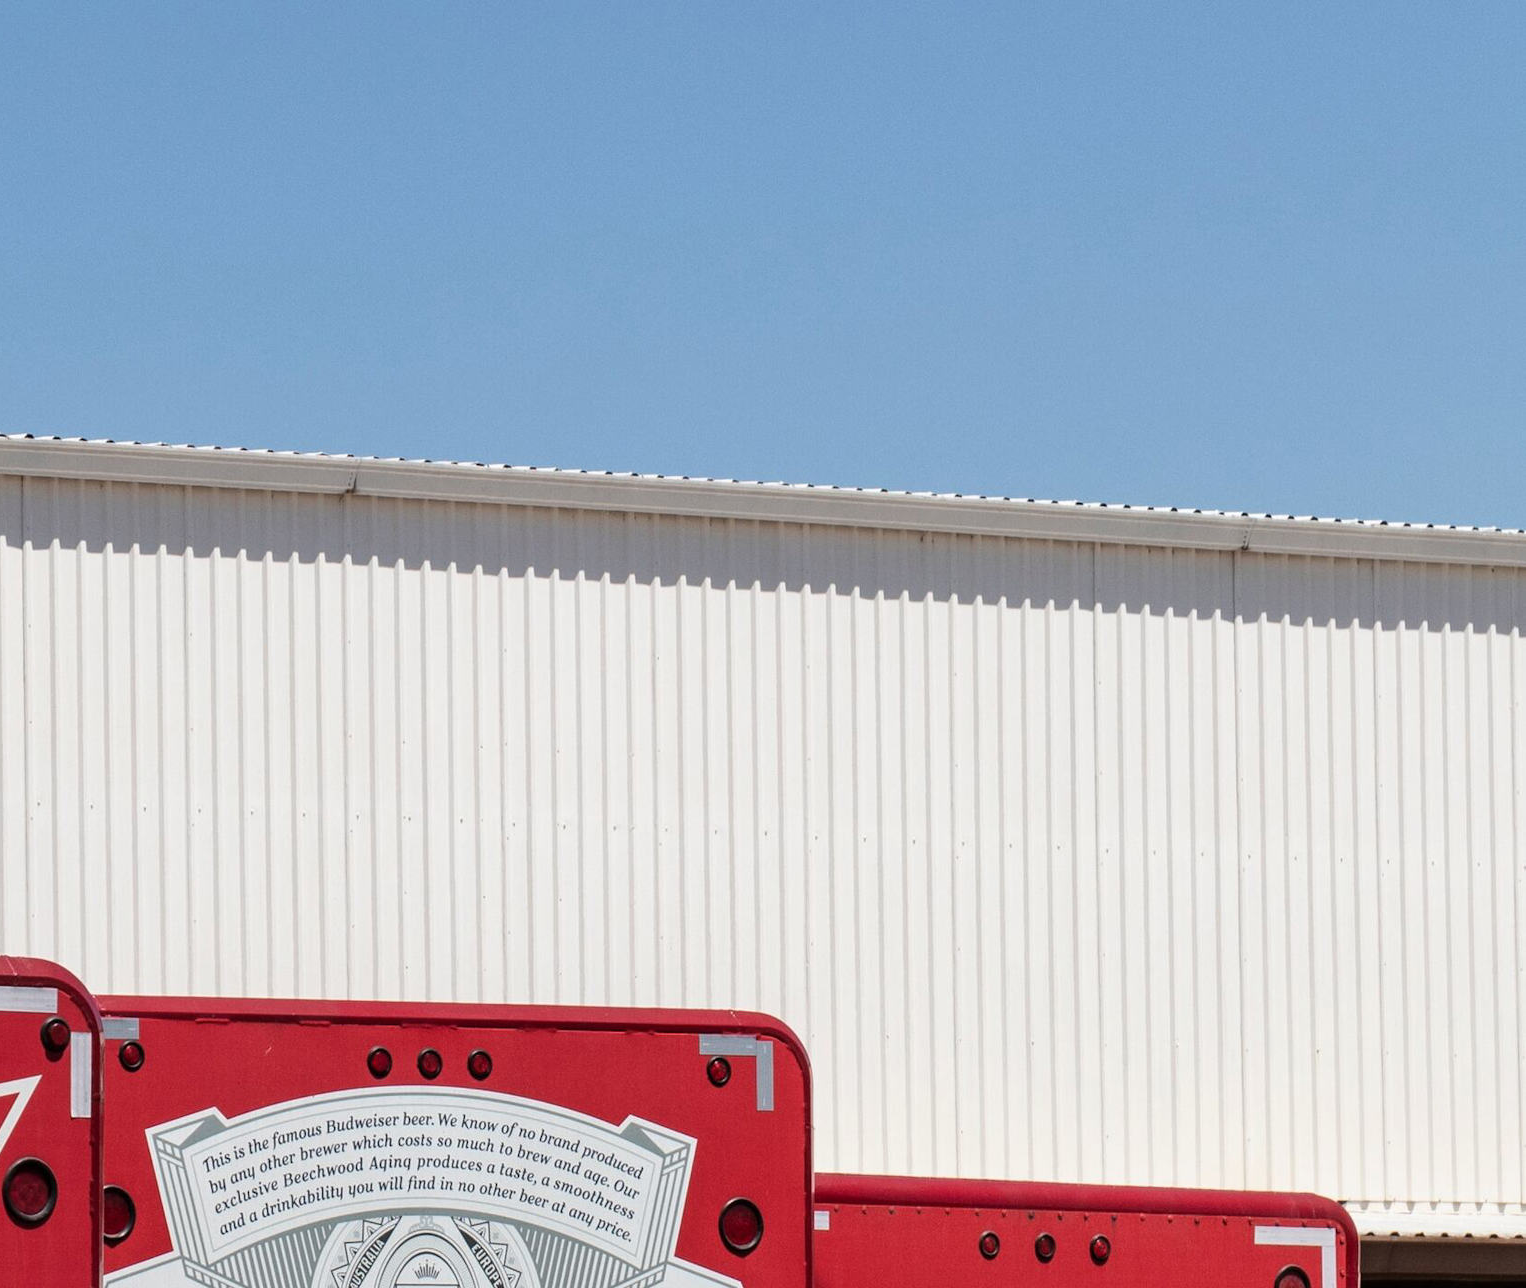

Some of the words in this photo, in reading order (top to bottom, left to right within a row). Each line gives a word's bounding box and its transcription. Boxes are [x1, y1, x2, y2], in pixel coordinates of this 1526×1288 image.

[220, 1212, 246, 1235] and
[249, 1211, 258, 1223] a
[262, 1186, 343, 1218] drinkability
[348, 1183, 374, 1198] you
[378, 1176, 403, 1191] will
[407, 1176, 435, 1192] find
[440, 1176, 453, 1190] in
[458, 1182, 475, 1193] no
[479, 1183, 516, 1199] other
[519, 1188, 549, 1208] beer
[551, 1202, 566, 1214] at
[569, 1208, 594, 1227] any
[596, 1219, 631, 1242] price.
